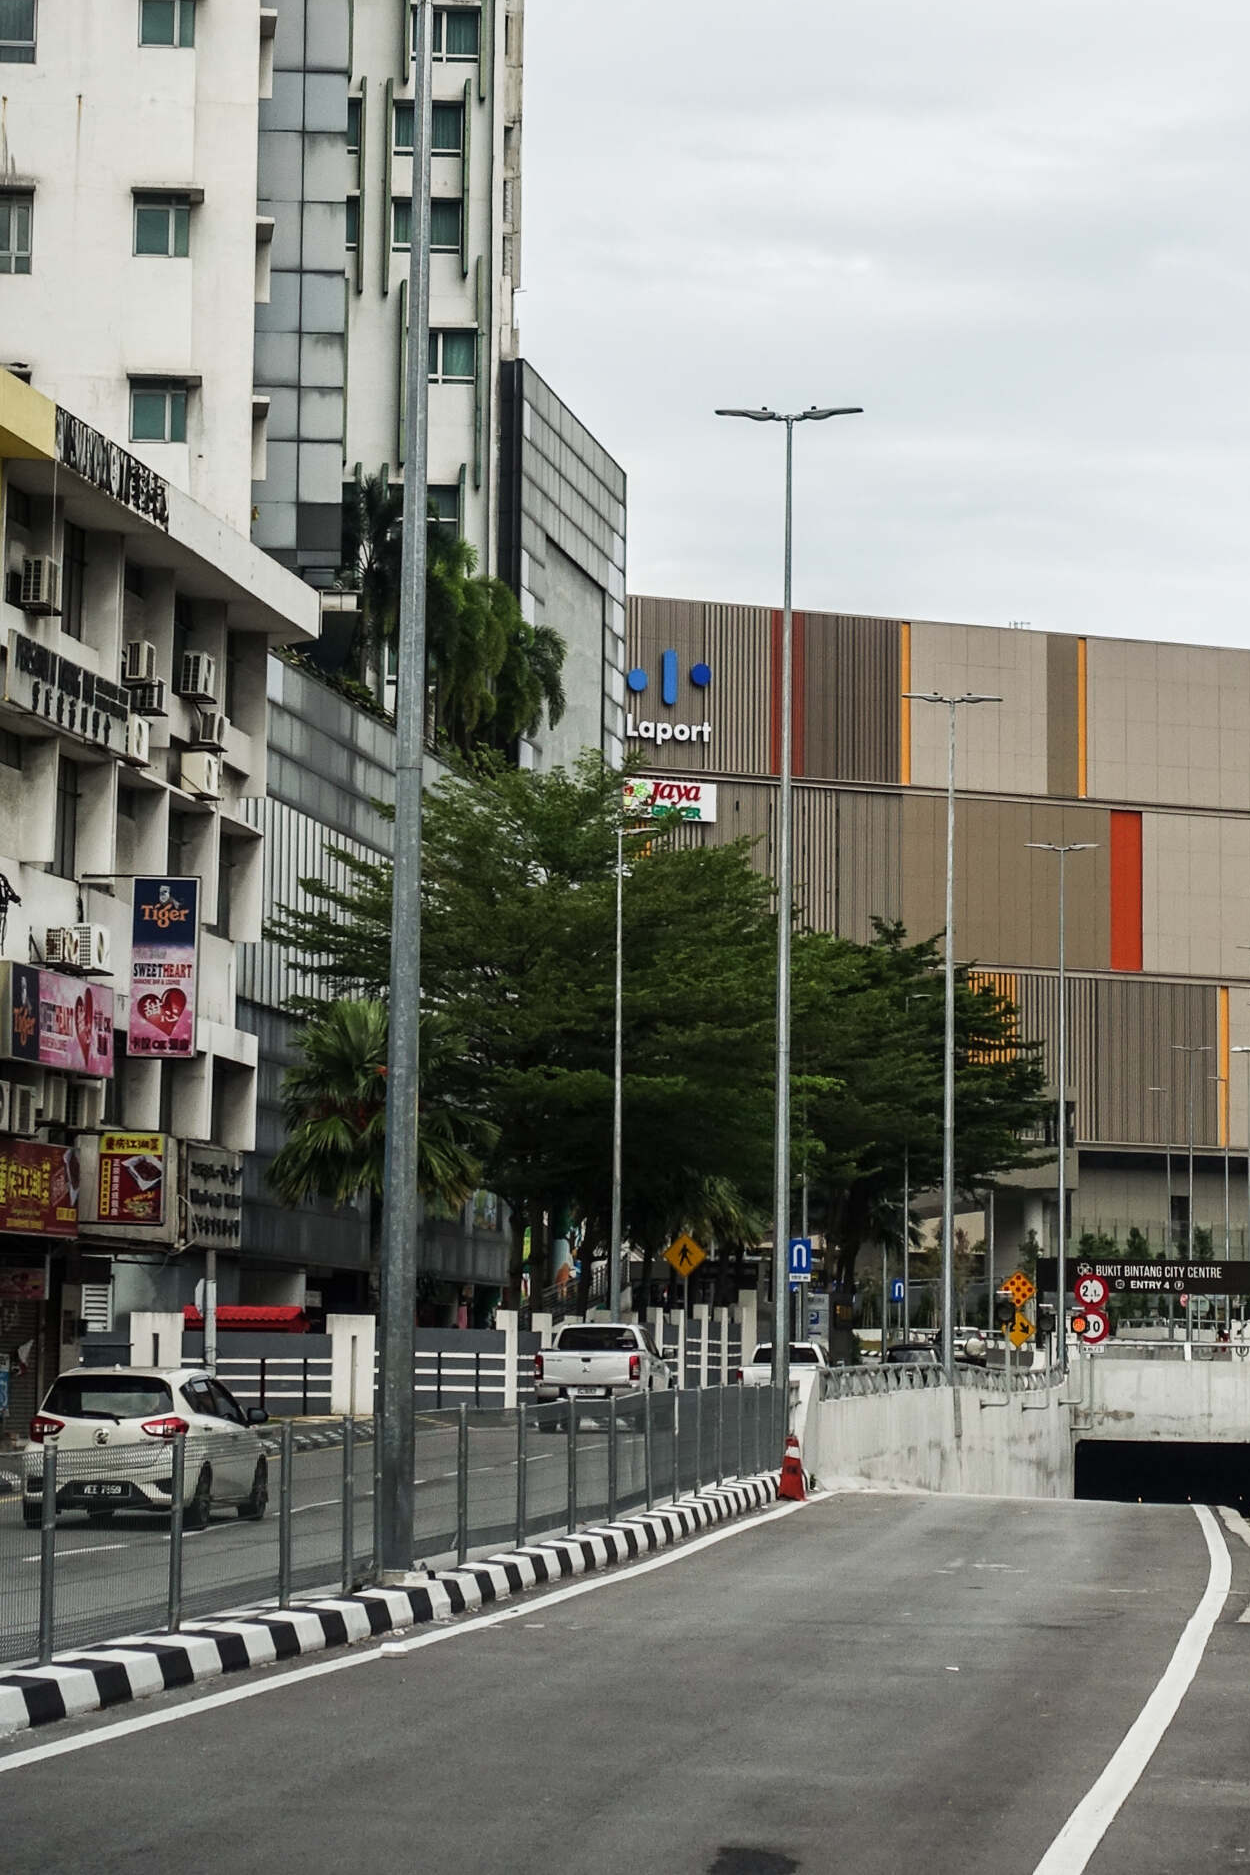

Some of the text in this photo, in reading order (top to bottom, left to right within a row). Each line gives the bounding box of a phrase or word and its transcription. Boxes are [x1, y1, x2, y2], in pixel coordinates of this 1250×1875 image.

[626, 713, 712, 745] Laport
[651, 782, 701, 805] Jaya
[141, 903, 190, 928] Tiger
[133, 963, 192, 978] SWEETHEART
[1096, 1265, 1223, 1279] BUKIT BINTANG CITY CENTRE
[1130, 1280, 1162, 1289] ENTRY
[1163, 1281, 1170, 1289] 4
